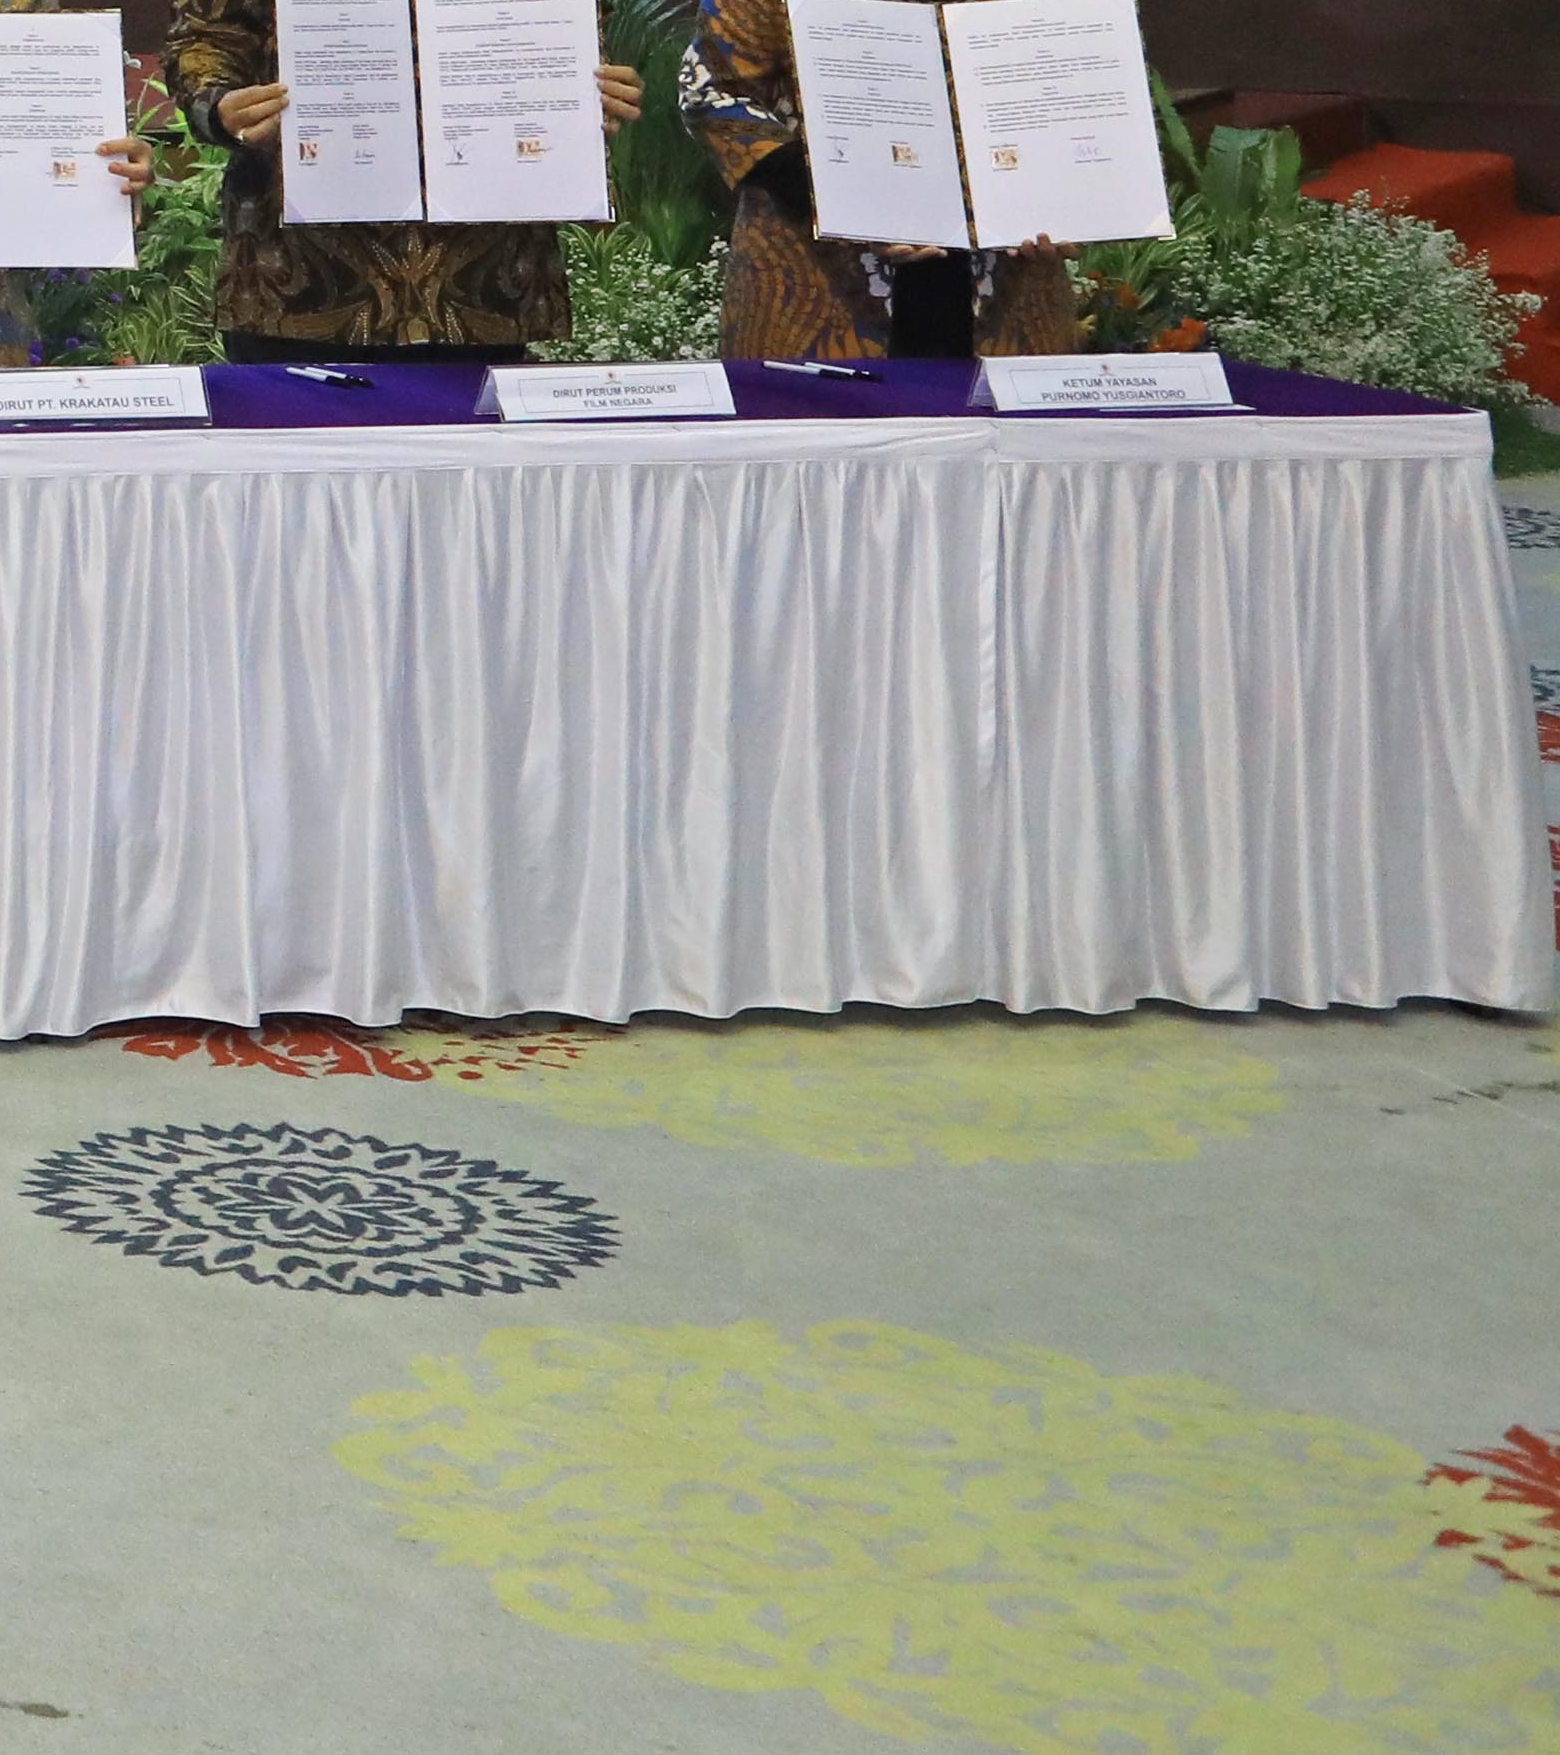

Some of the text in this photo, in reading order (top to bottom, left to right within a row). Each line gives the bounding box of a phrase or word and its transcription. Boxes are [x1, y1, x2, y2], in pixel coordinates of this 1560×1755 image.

[1063, 377, 1157, 388] KETUM YAYASAN
[552, 384, 676, 399] DIRUT PERUM PRODUKSI
[1041, 389, 1186, 402] PURNOMO YUSGIANTORO
[59, 397, 129, 409] KRAKATAU
[133, 396, 174, 407] STEEL
[583, 397, 653, 408] FILM NEGARA
